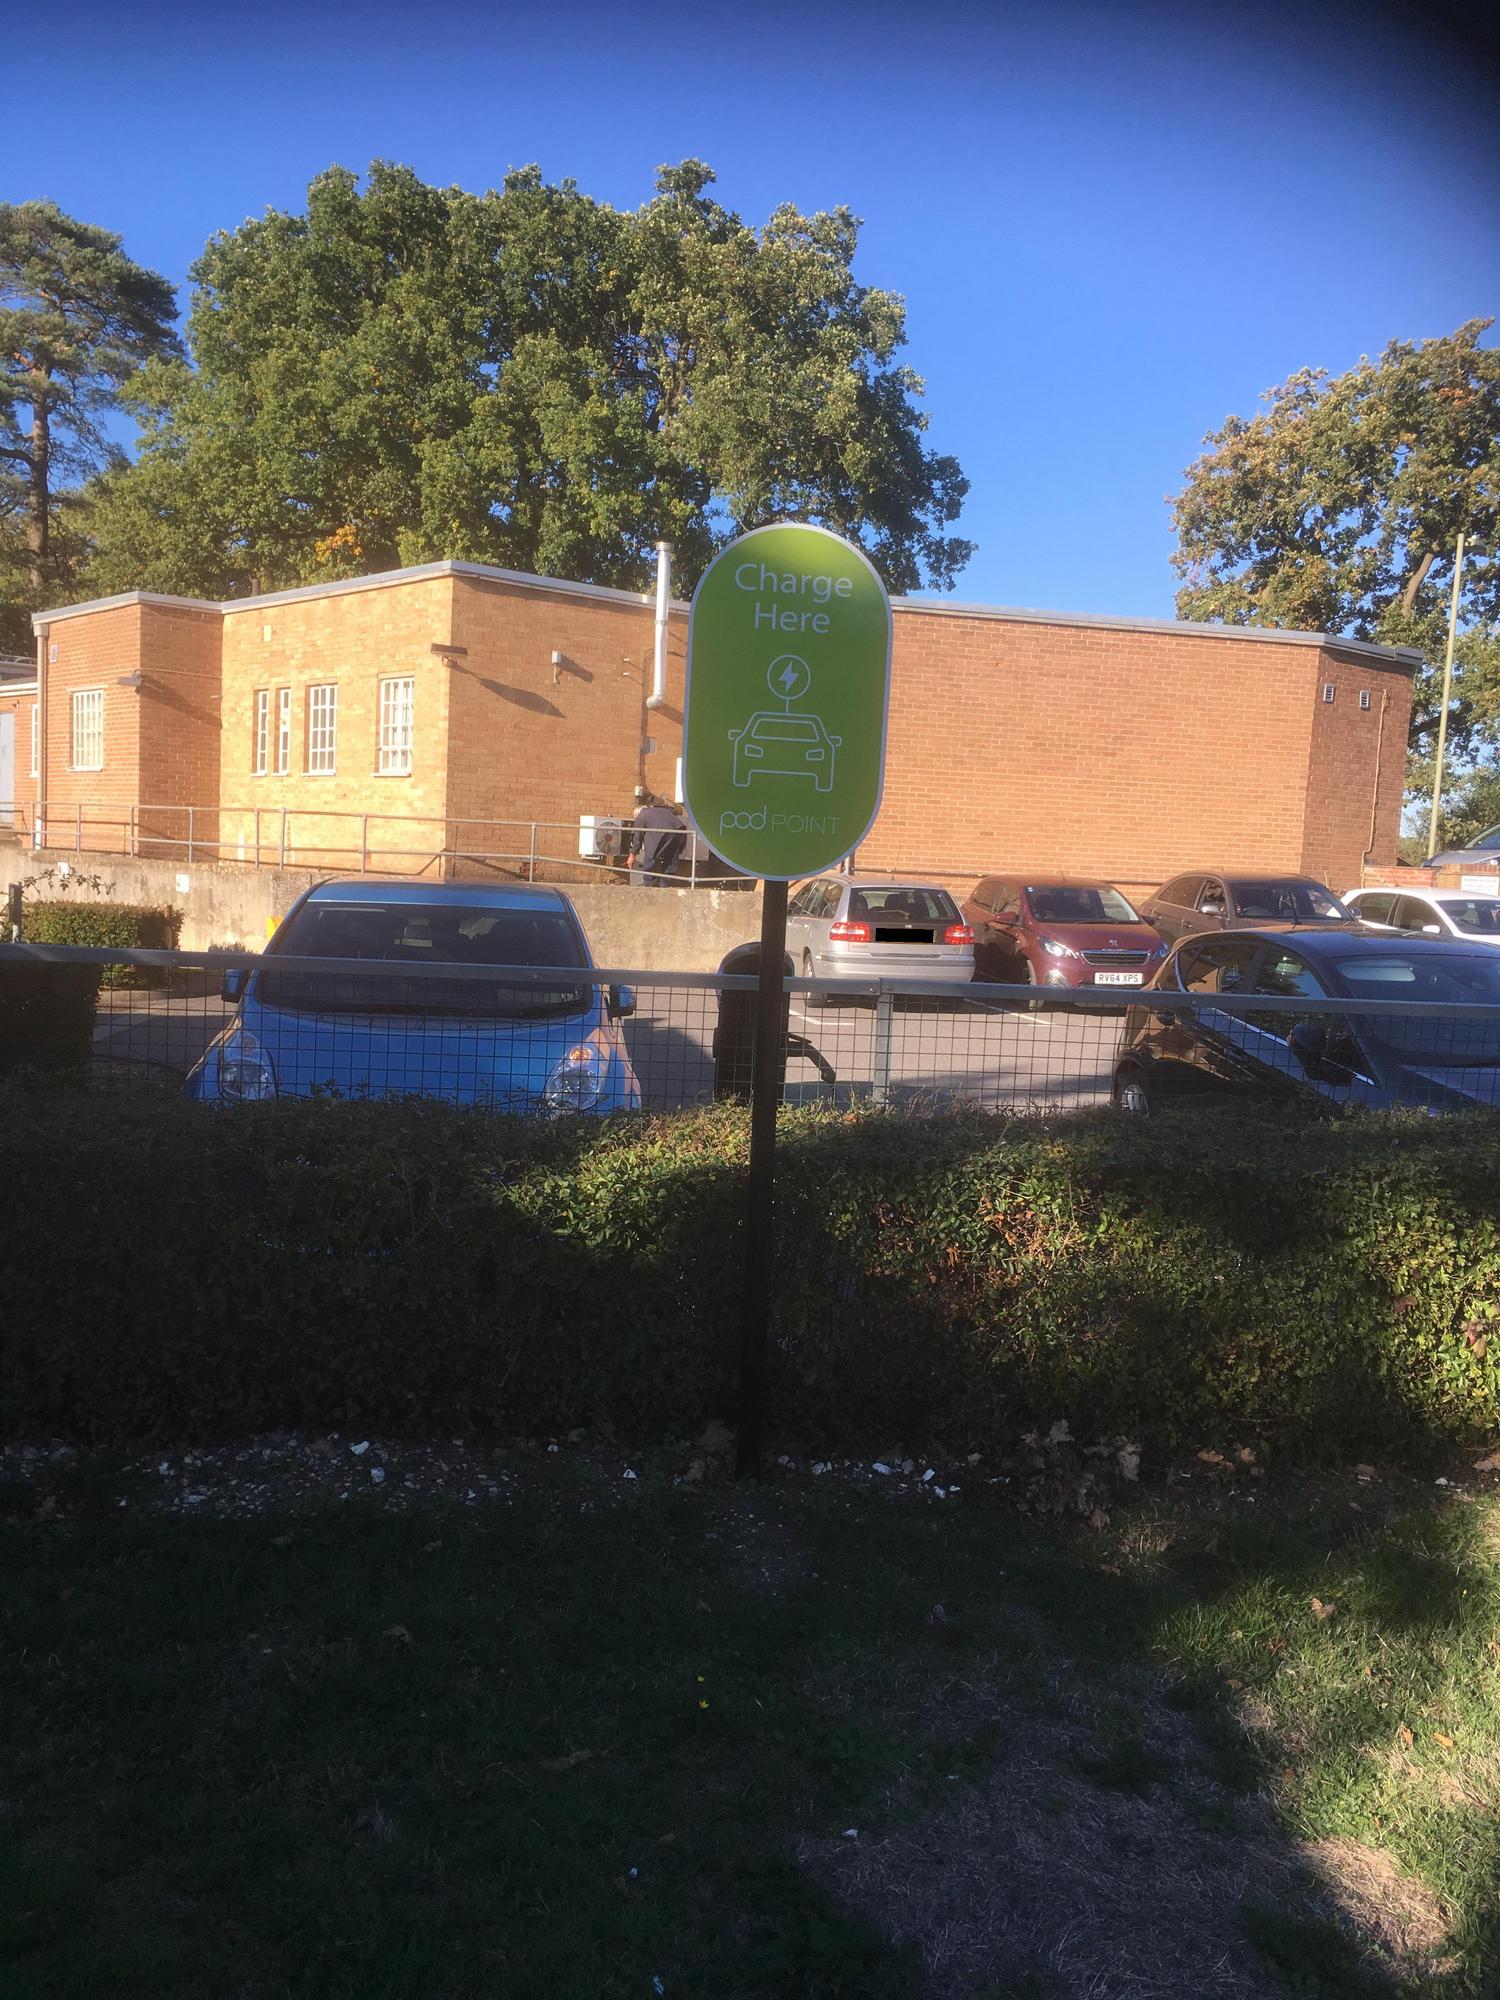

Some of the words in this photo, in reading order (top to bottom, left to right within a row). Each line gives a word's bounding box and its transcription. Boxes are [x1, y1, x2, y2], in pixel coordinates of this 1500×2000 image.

[735, 563, 853, 603] Charge
[755, 602, 830, 633] Here
[720, 805, 767, 835] pod
[771, 814, 841, 834] POINT
[1098, 974, 1120, 983] RV64
[1122, 974, 1139, 983] XPS
